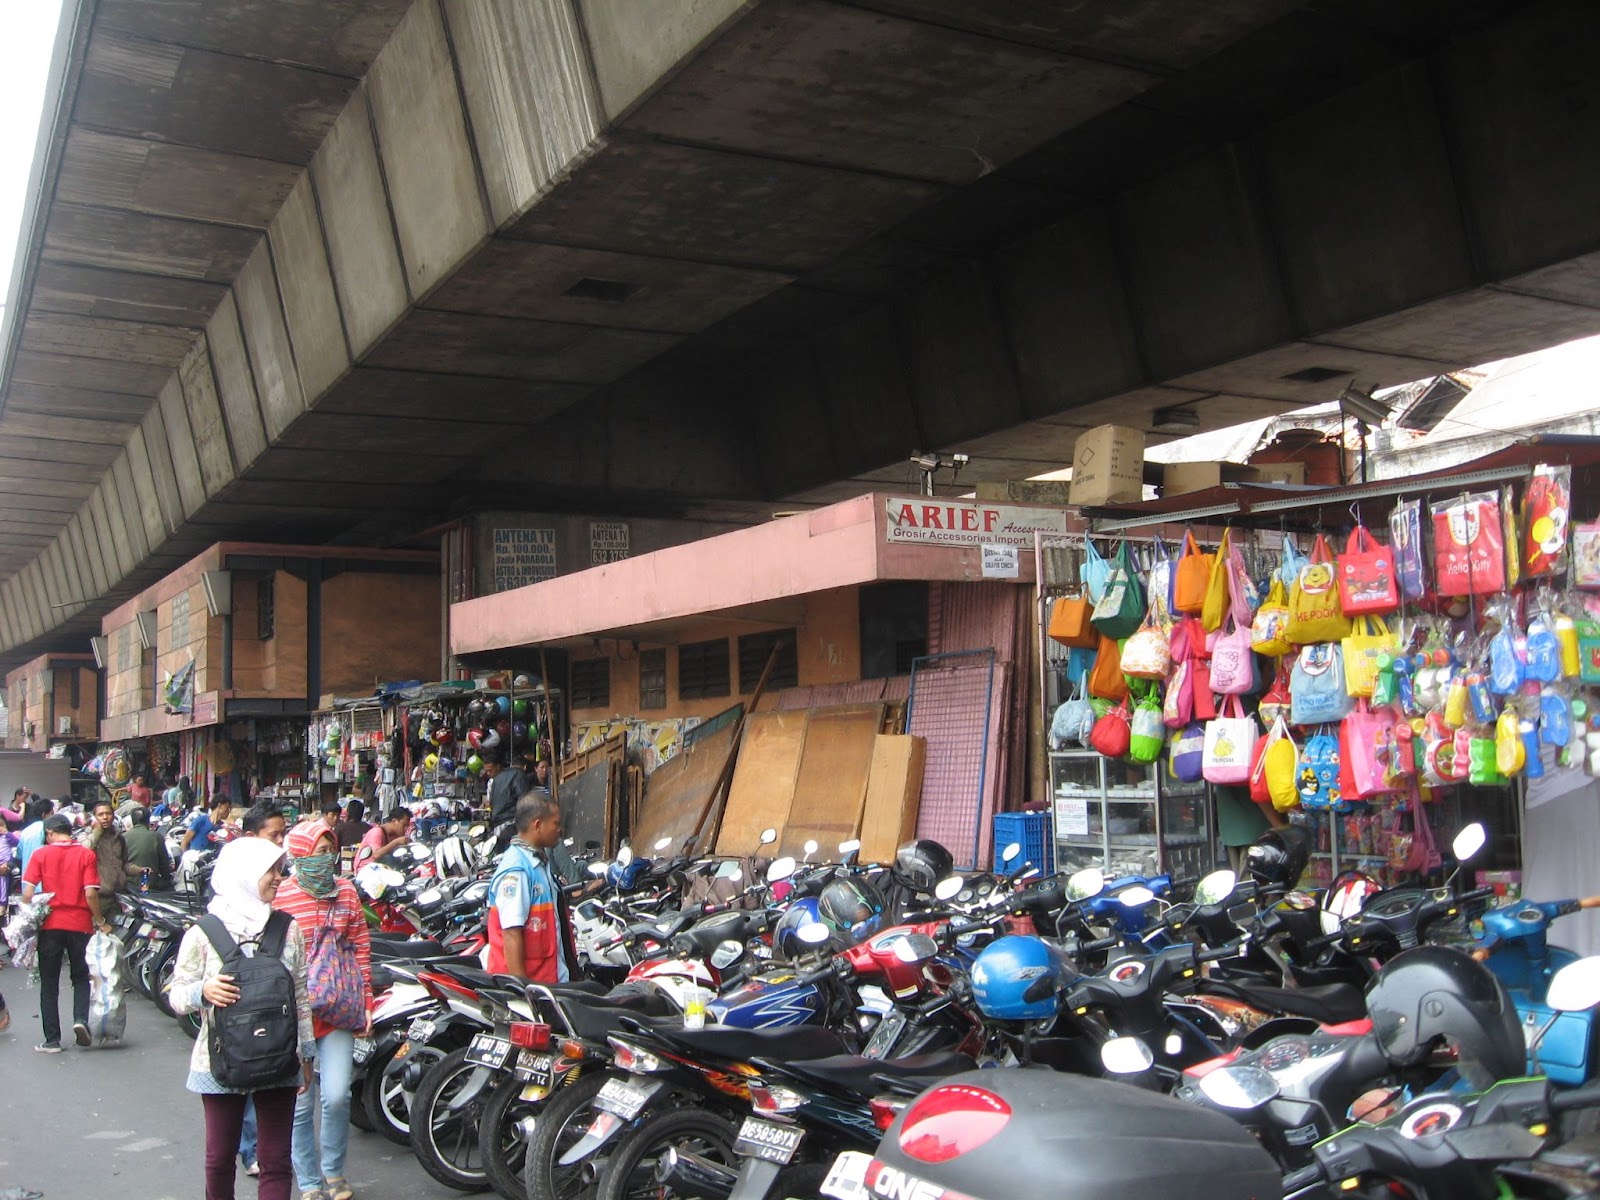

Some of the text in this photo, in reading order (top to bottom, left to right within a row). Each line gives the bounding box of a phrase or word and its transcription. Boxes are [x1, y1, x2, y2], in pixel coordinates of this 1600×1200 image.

[896, 504, 1001, 533] ARIEF
[495, 530, 554, 543] ANTENA TV
[592, 530, 628, 541] ANTENA TV
[893, 528, 927, 539] Grosir
[929, 531, 992, 544] Accessories
[995, 535, 1027, 546] Import
[496, 544, 510, 554] Rp.
[516, 555, 554, 564] PARABOLA
[592, 550, 608, 563] 632
[1446, 560, 1491, 575] Hello Kitty
